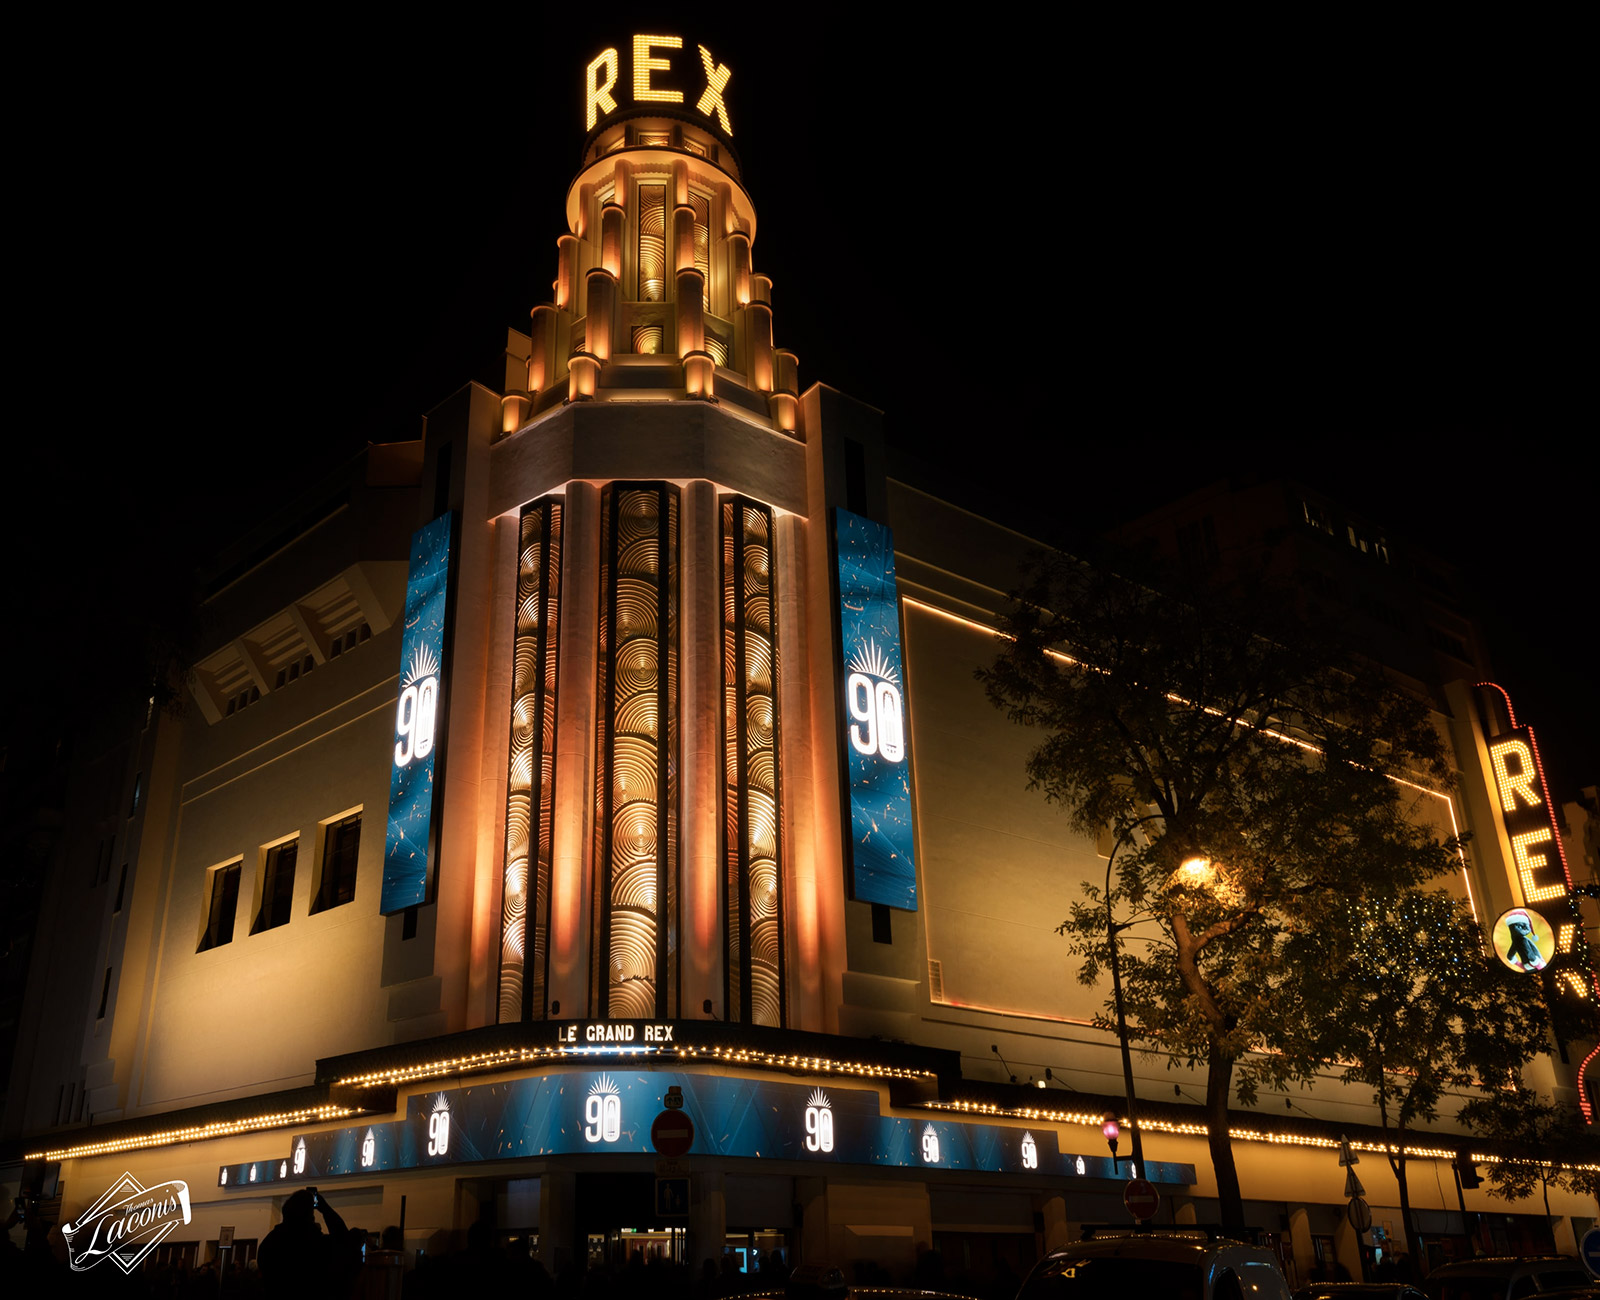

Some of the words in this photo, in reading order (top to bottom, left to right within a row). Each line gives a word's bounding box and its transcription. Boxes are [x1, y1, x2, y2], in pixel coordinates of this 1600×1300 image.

[586, 34, 733, 137] REX
[394, 676, 438, 767] 90
[846, 673, 905, 763] 90
[558, 1025, 577, 1042] LE
[586, 1024, 635, 1042] GRAND
[644, 1024, 674, 1042] REX
[428, 1111, 449, 1156] 90
[585, 1094, 621, 1143] 90
[805, 1107, 834, 1153] 90
[293, 1148, 306, 1174] 90
[361, 1139, 376, 1167] 90
[922, 1135, 940, 1163] 90
[1021, 1142, 1038, 1169] 90
